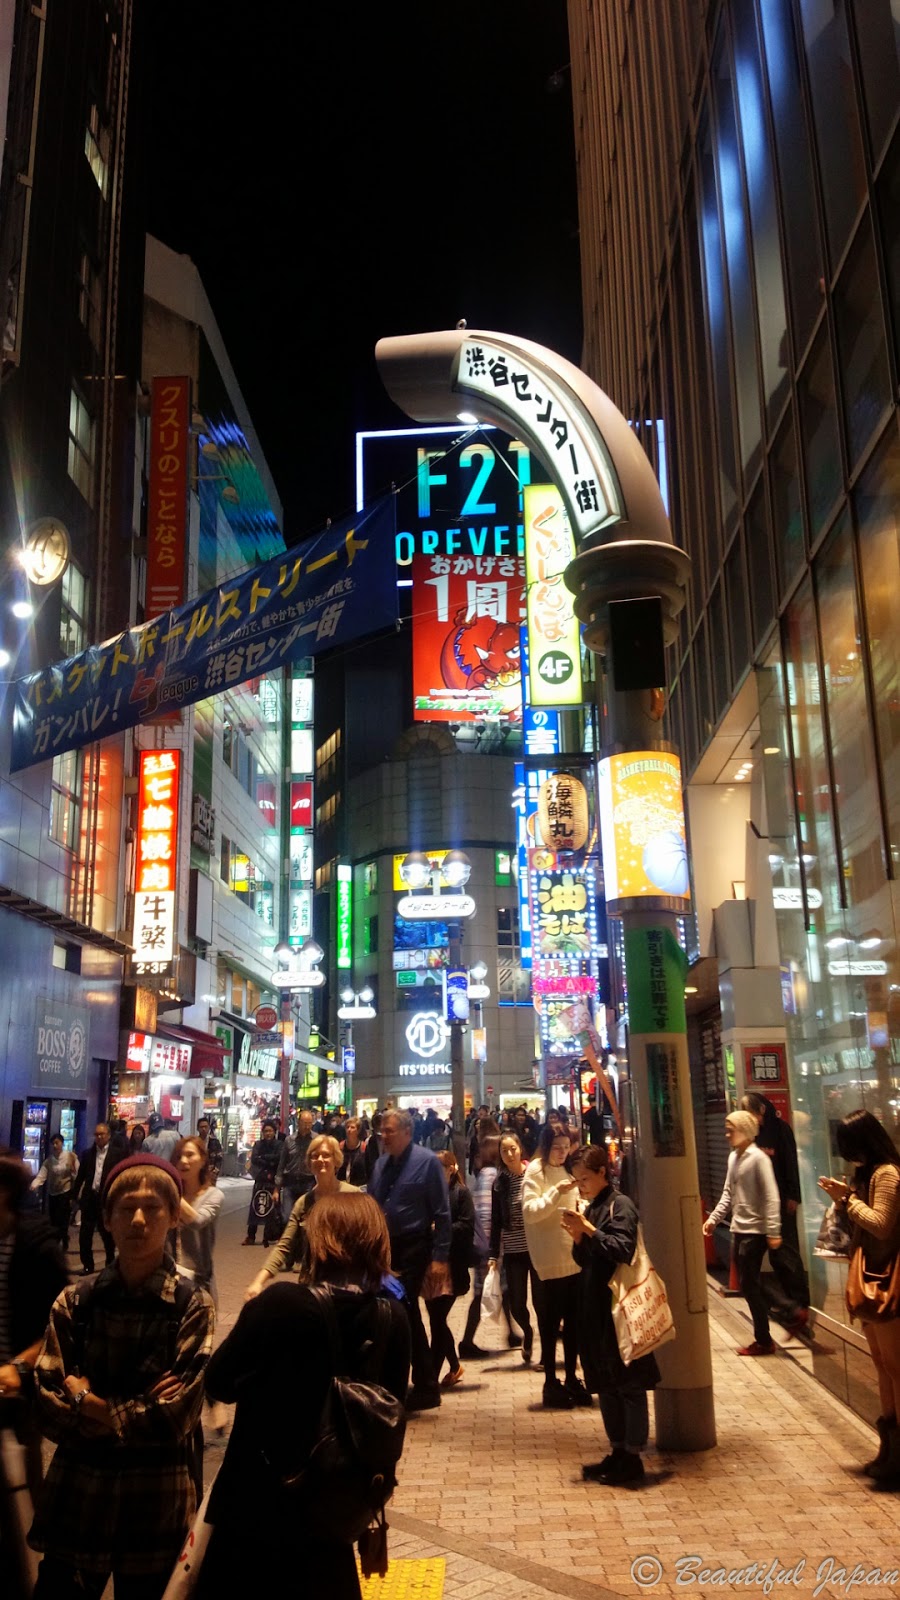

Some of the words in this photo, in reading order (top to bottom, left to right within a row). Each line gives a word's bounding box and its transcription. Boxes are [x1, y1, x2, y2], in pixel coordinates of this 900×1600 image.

[465, 346, 600, 513] 渋谷センター街
[154, 386, 181, 567] クスリのことなら
[430, 555, 526, 577] おかげさ
[424, 575, 526, 623] 1周
[204, 600, 346, 689] 渋谷センター街
[539, 656, 570, 678] 4F
[538, 873, 587, 913] 油
[140, 895, 167, 950] 牛繁
[538, 912, 588, 935] そば
[37, 1027, 66, 1057] BOSS
[40, 1059, 61, 1073] COFFEE
